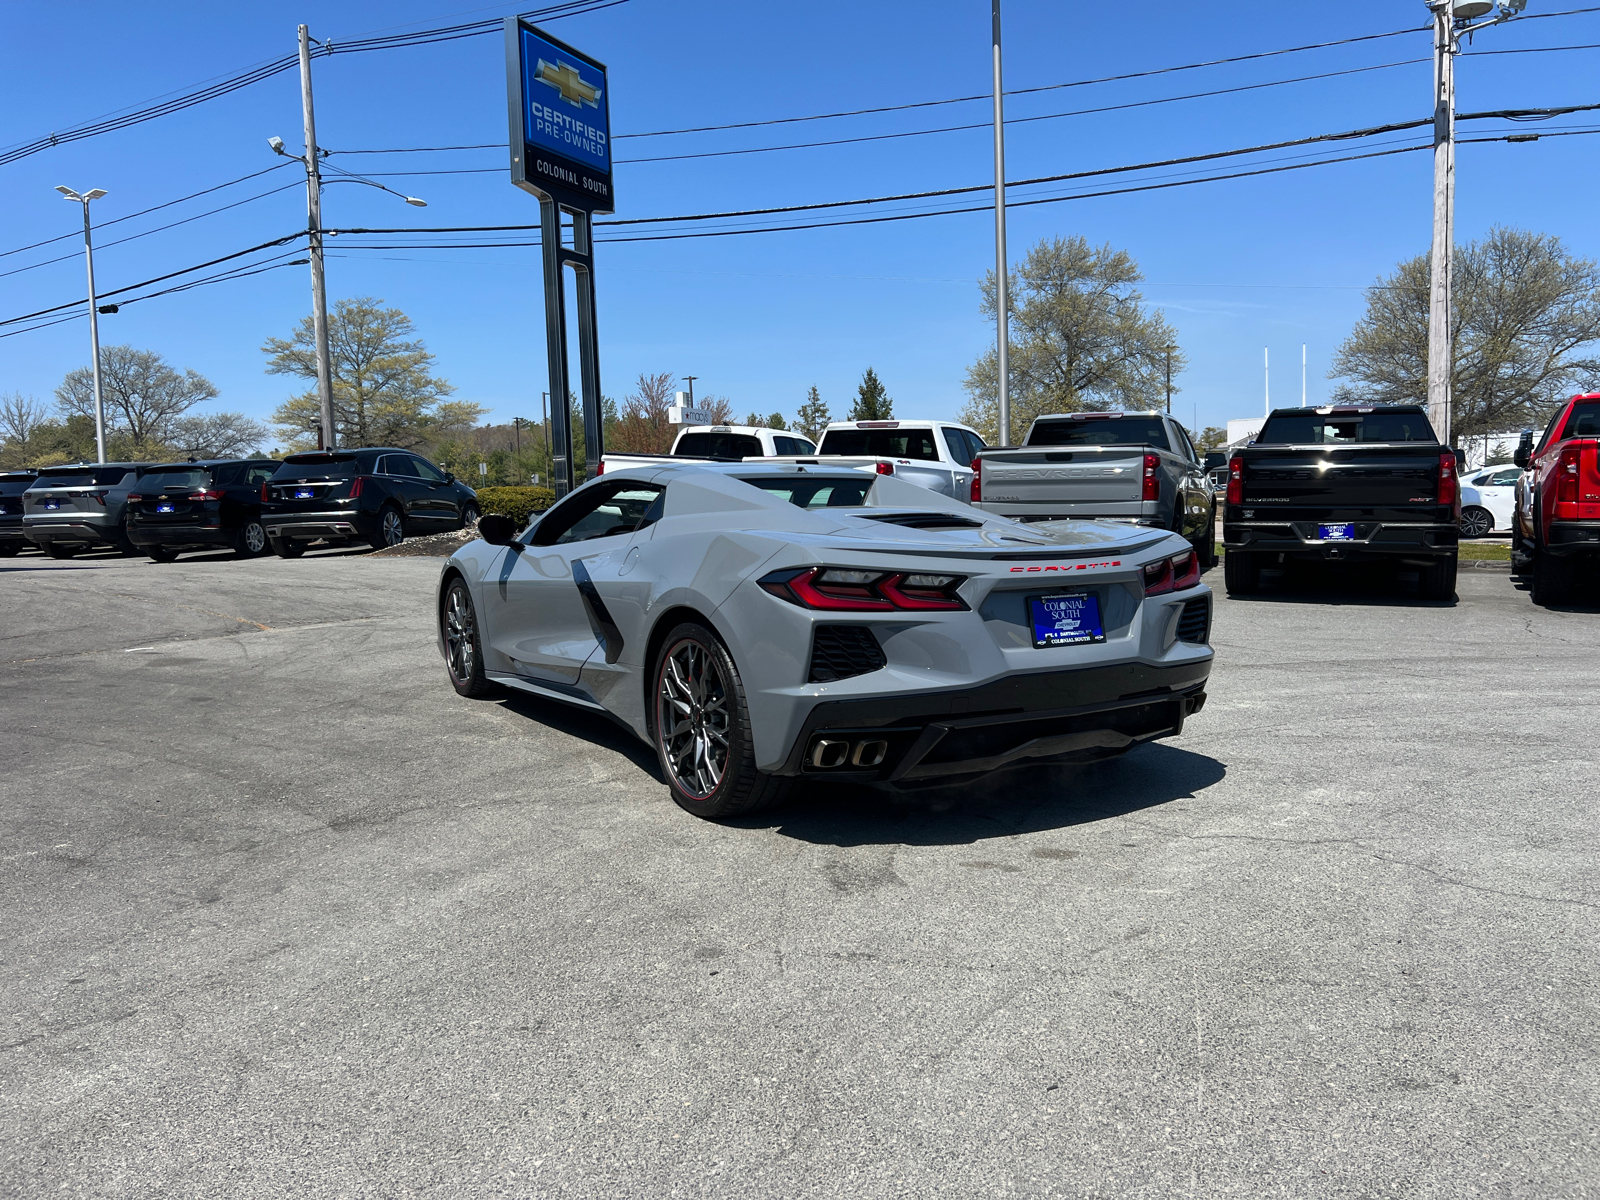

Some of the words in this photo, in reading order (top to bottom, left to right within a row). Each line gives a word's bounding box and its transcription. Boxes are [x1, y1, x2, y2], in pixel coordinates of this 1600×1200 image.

[532, 102, 606, 145] CERTIFIED
[537, 119, 604, 157] PRE-OWNED
[537, 160, 579, 185] COLONIAL
[583, 177, 608, 196] SOUTH
[690, 411, 709, 424] macy's
[1010, 561, 1121, 572] CORVETTE
[1044, 600, 1086, 612] COLONIAL
[1051, 609, 1081, 620] SOUTH
